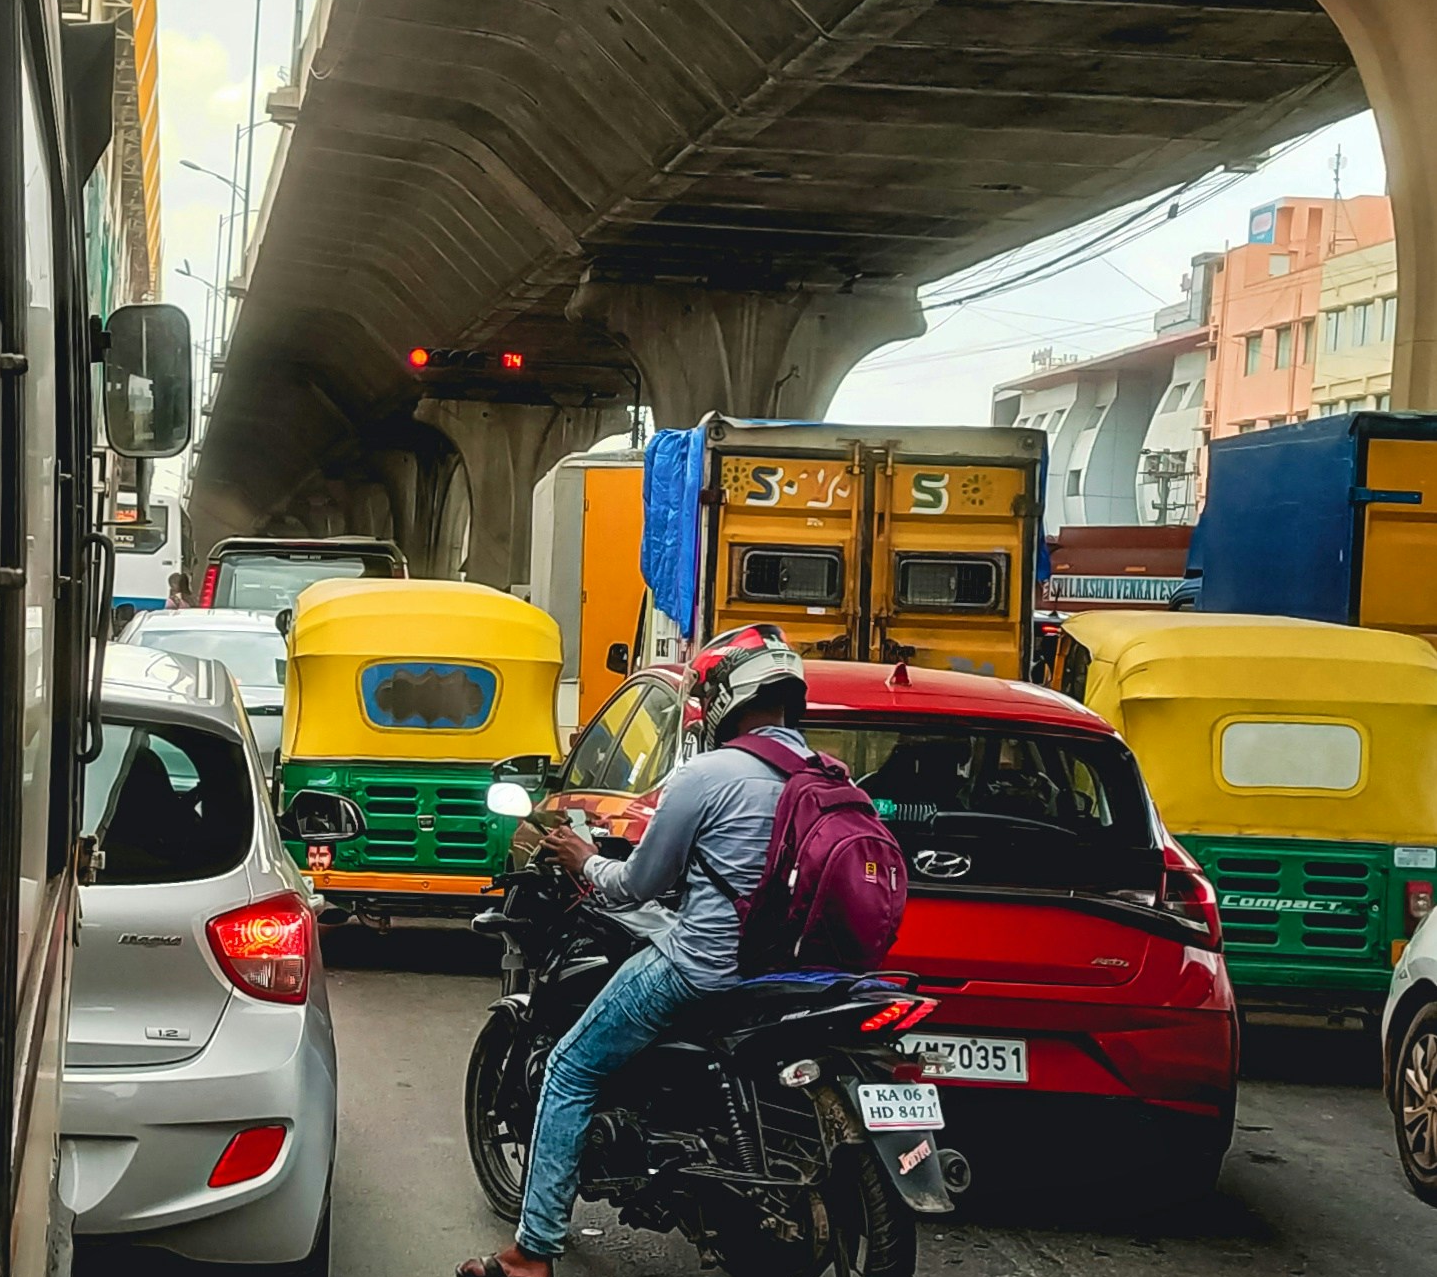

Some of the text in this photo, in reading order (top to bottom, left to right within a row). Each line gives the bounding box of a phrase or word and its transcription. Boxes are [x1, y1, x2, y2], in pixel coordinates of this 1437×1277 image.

[504, 354, 522, 367] 74
[876, 1089, 922, 1102] KA 06
[869, 1106, 935, 1119] HD 8471
